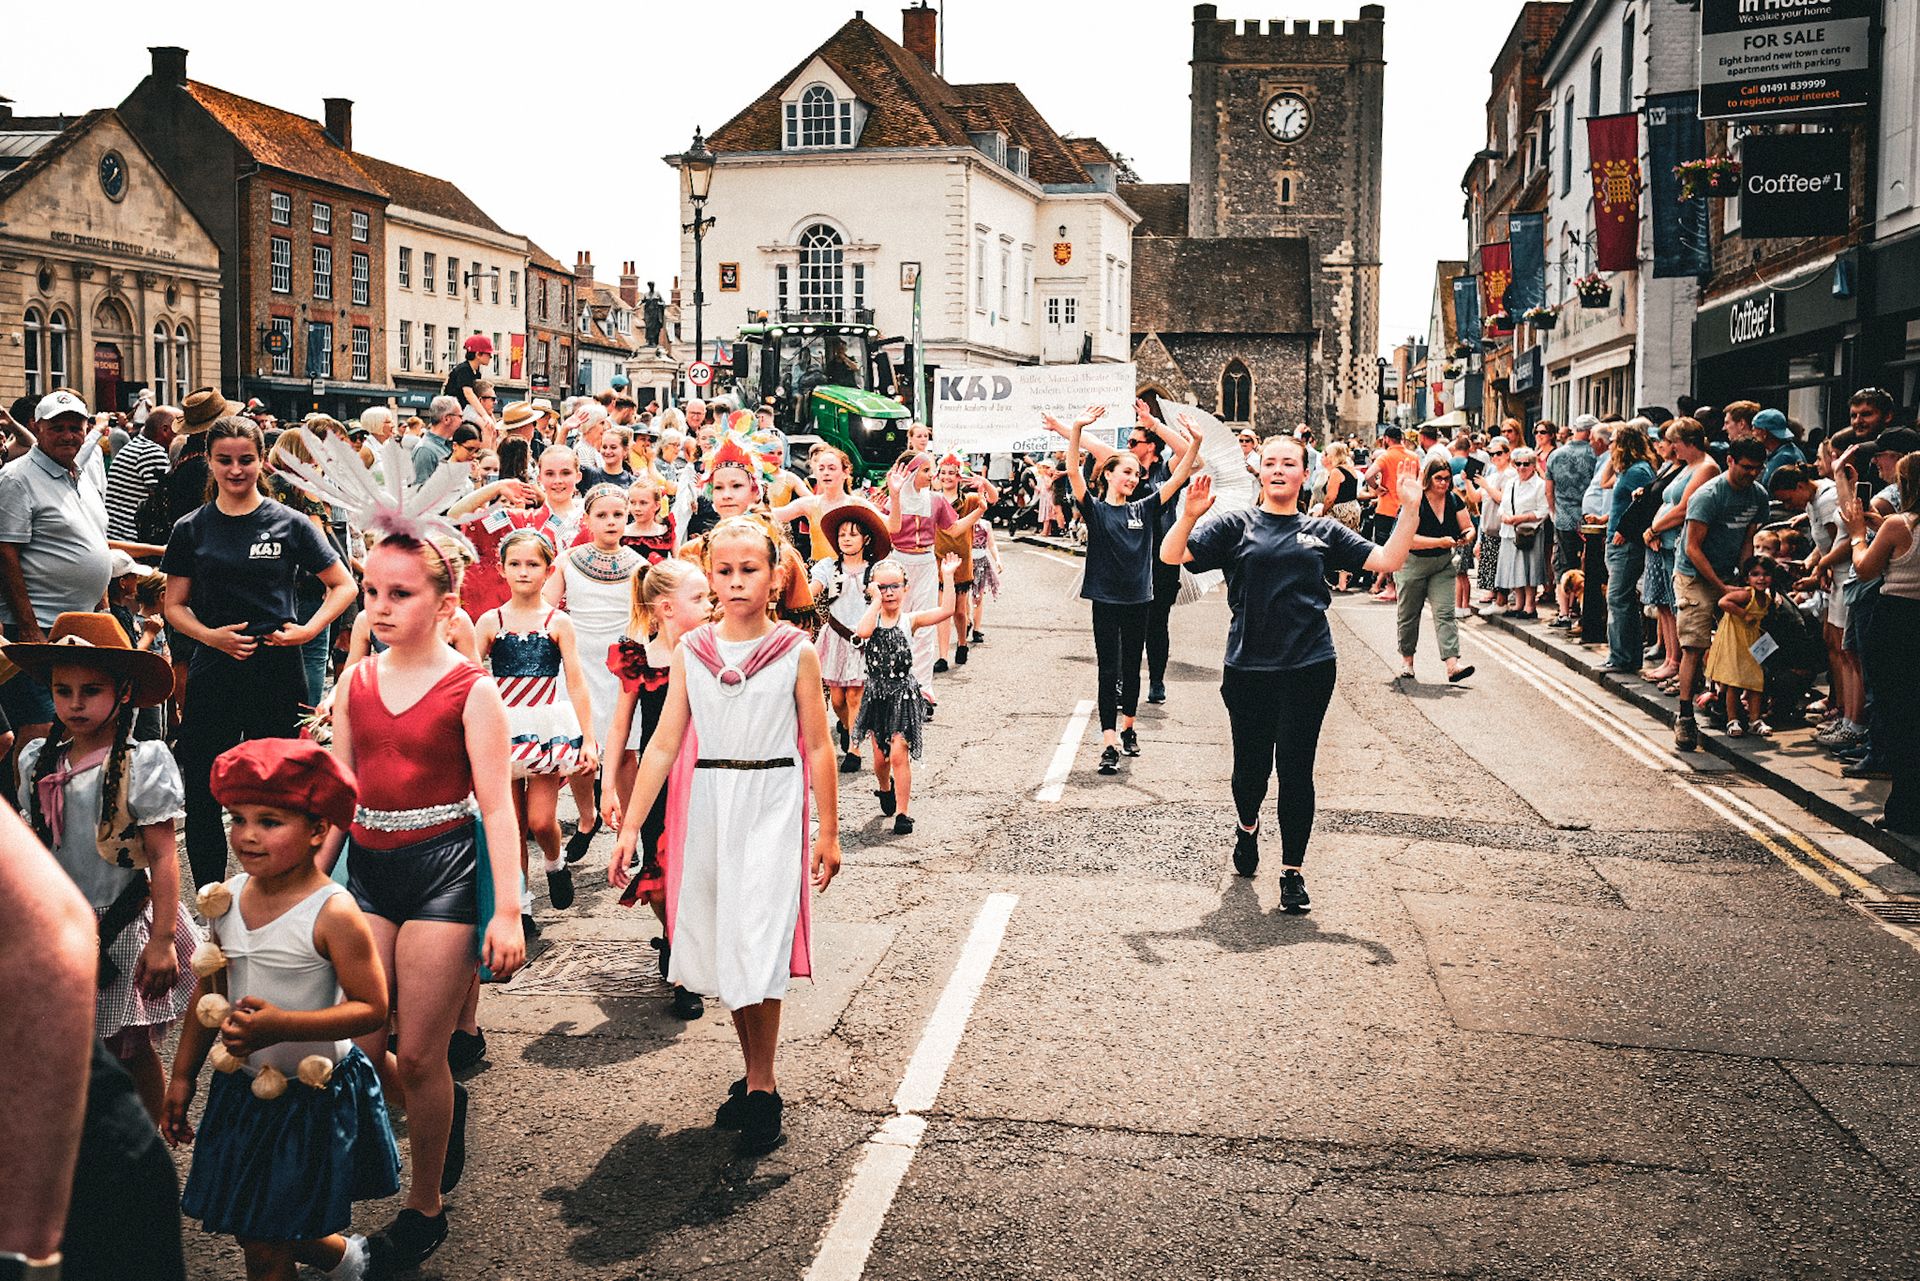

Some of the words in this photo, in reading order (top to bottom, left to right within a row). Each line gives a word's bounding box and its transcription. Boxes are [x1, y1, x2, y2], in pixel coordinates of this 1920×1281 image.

[1739, 14, 1753, 23] We
[1755, 12, 1780, 21] value
[1781, 10, 1803, 20] your
[1804, 6, 1833, 16] home
[1744, 34, 1779, 50] FOR
[1783, 28, 1825, 46] SALE
[1719, 56, 1742, 67] Eight
[1744, 53, 1771, 64] brand
[1773, 51, 1793, 60] new
[1795, 48, 1818, 58] town
[1821, 46, 1851, 55] centre
[1727, 62, 1780, 76] apartments
[1781, 60, 1802, 69] with
[1804, 57, 1841, 70] parking
[1741, 85, 1759, 95] Call
[1760, 83, 1788, 94] 01491
[1790, 79, 1827, 90] 839999
[1727, 100, 1738, 108] to
[1740, 96, 1776, 107] register
[1778, 95, 1800, 104] your
[1802, 90, 1840, 100] interest
[692, 368, 709, 379] 20
[940, 375, 1012, 401] KAD
[1012, 440, 1048, 451] Ofsted
[249, 542, 282, 556] KAD
